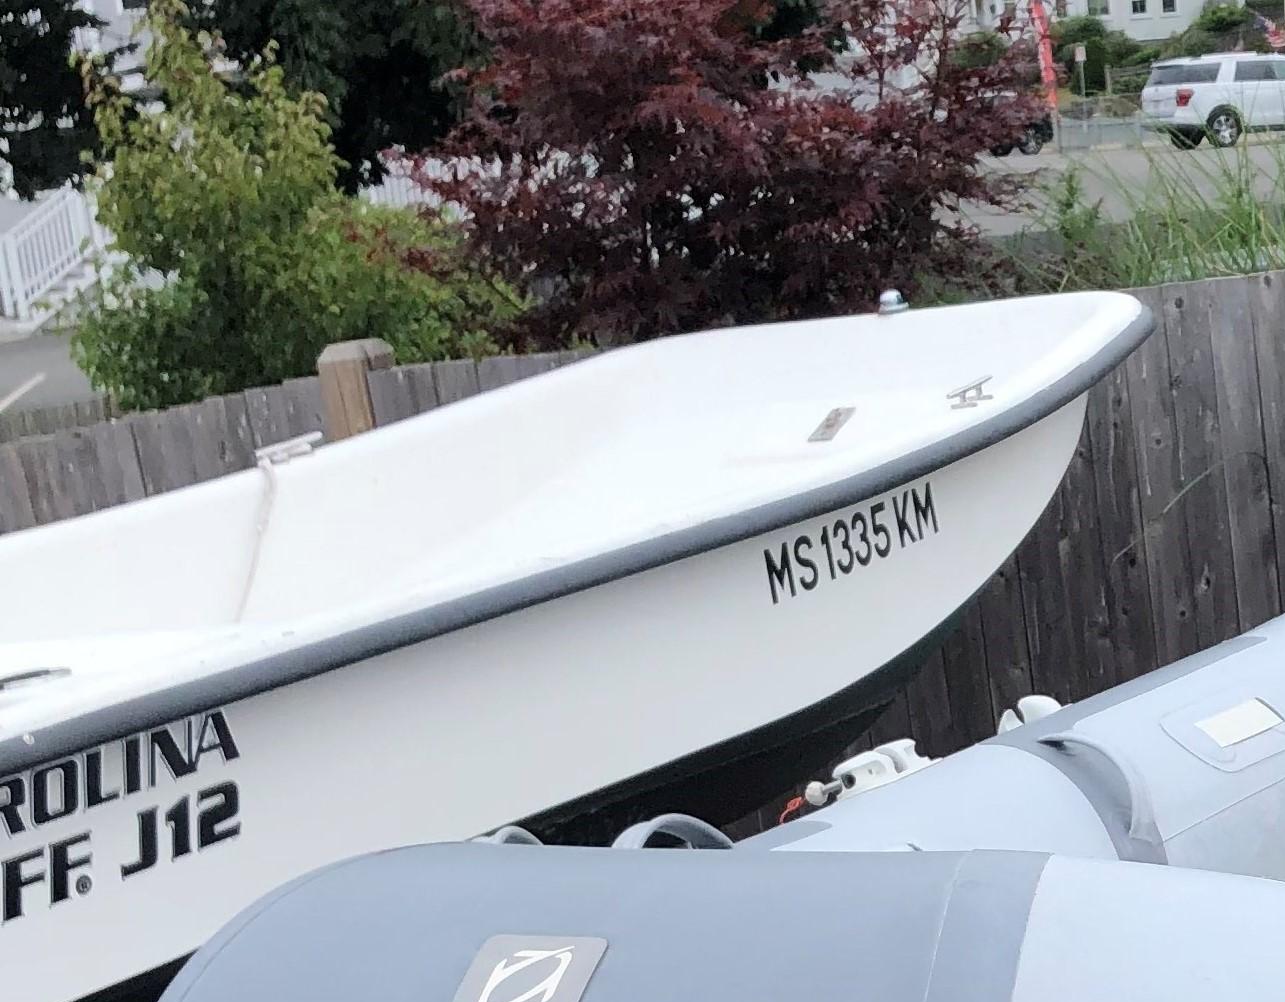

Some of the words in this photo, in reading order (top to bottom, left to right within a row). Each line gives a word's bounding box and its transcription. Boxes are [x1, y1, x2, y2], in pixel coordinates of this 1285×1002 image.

[763, 535, 819, 605] MS
[820, 501, 892, 580] 1335
[891, 481, 940, 548] KM
[120, 780, 242, 882] J12
